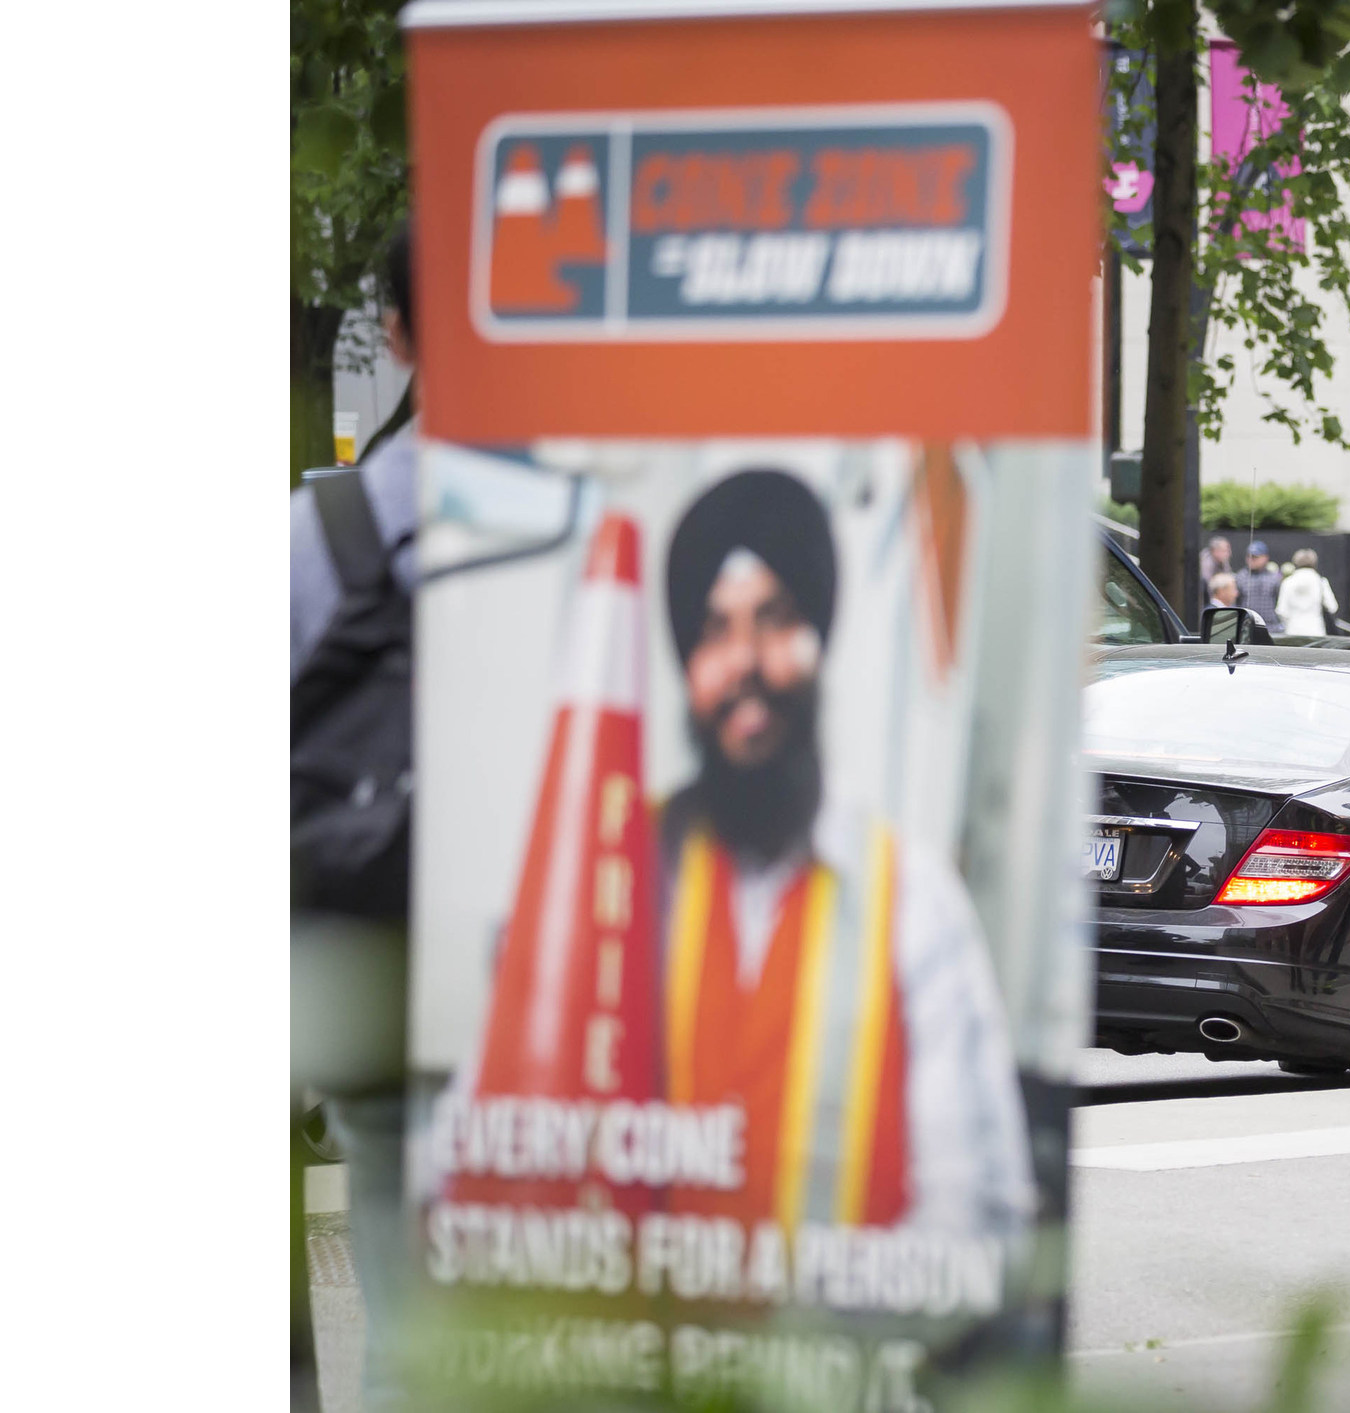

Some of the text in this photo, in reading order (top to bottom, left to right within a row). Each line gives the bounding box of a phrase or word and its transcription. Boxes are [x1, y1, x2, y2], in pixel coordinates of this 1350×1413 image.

[433, 1098, 746, 1190] EVERY CONE
[427, 1202, 1003, 1316] STANDS FOR A PERSON
